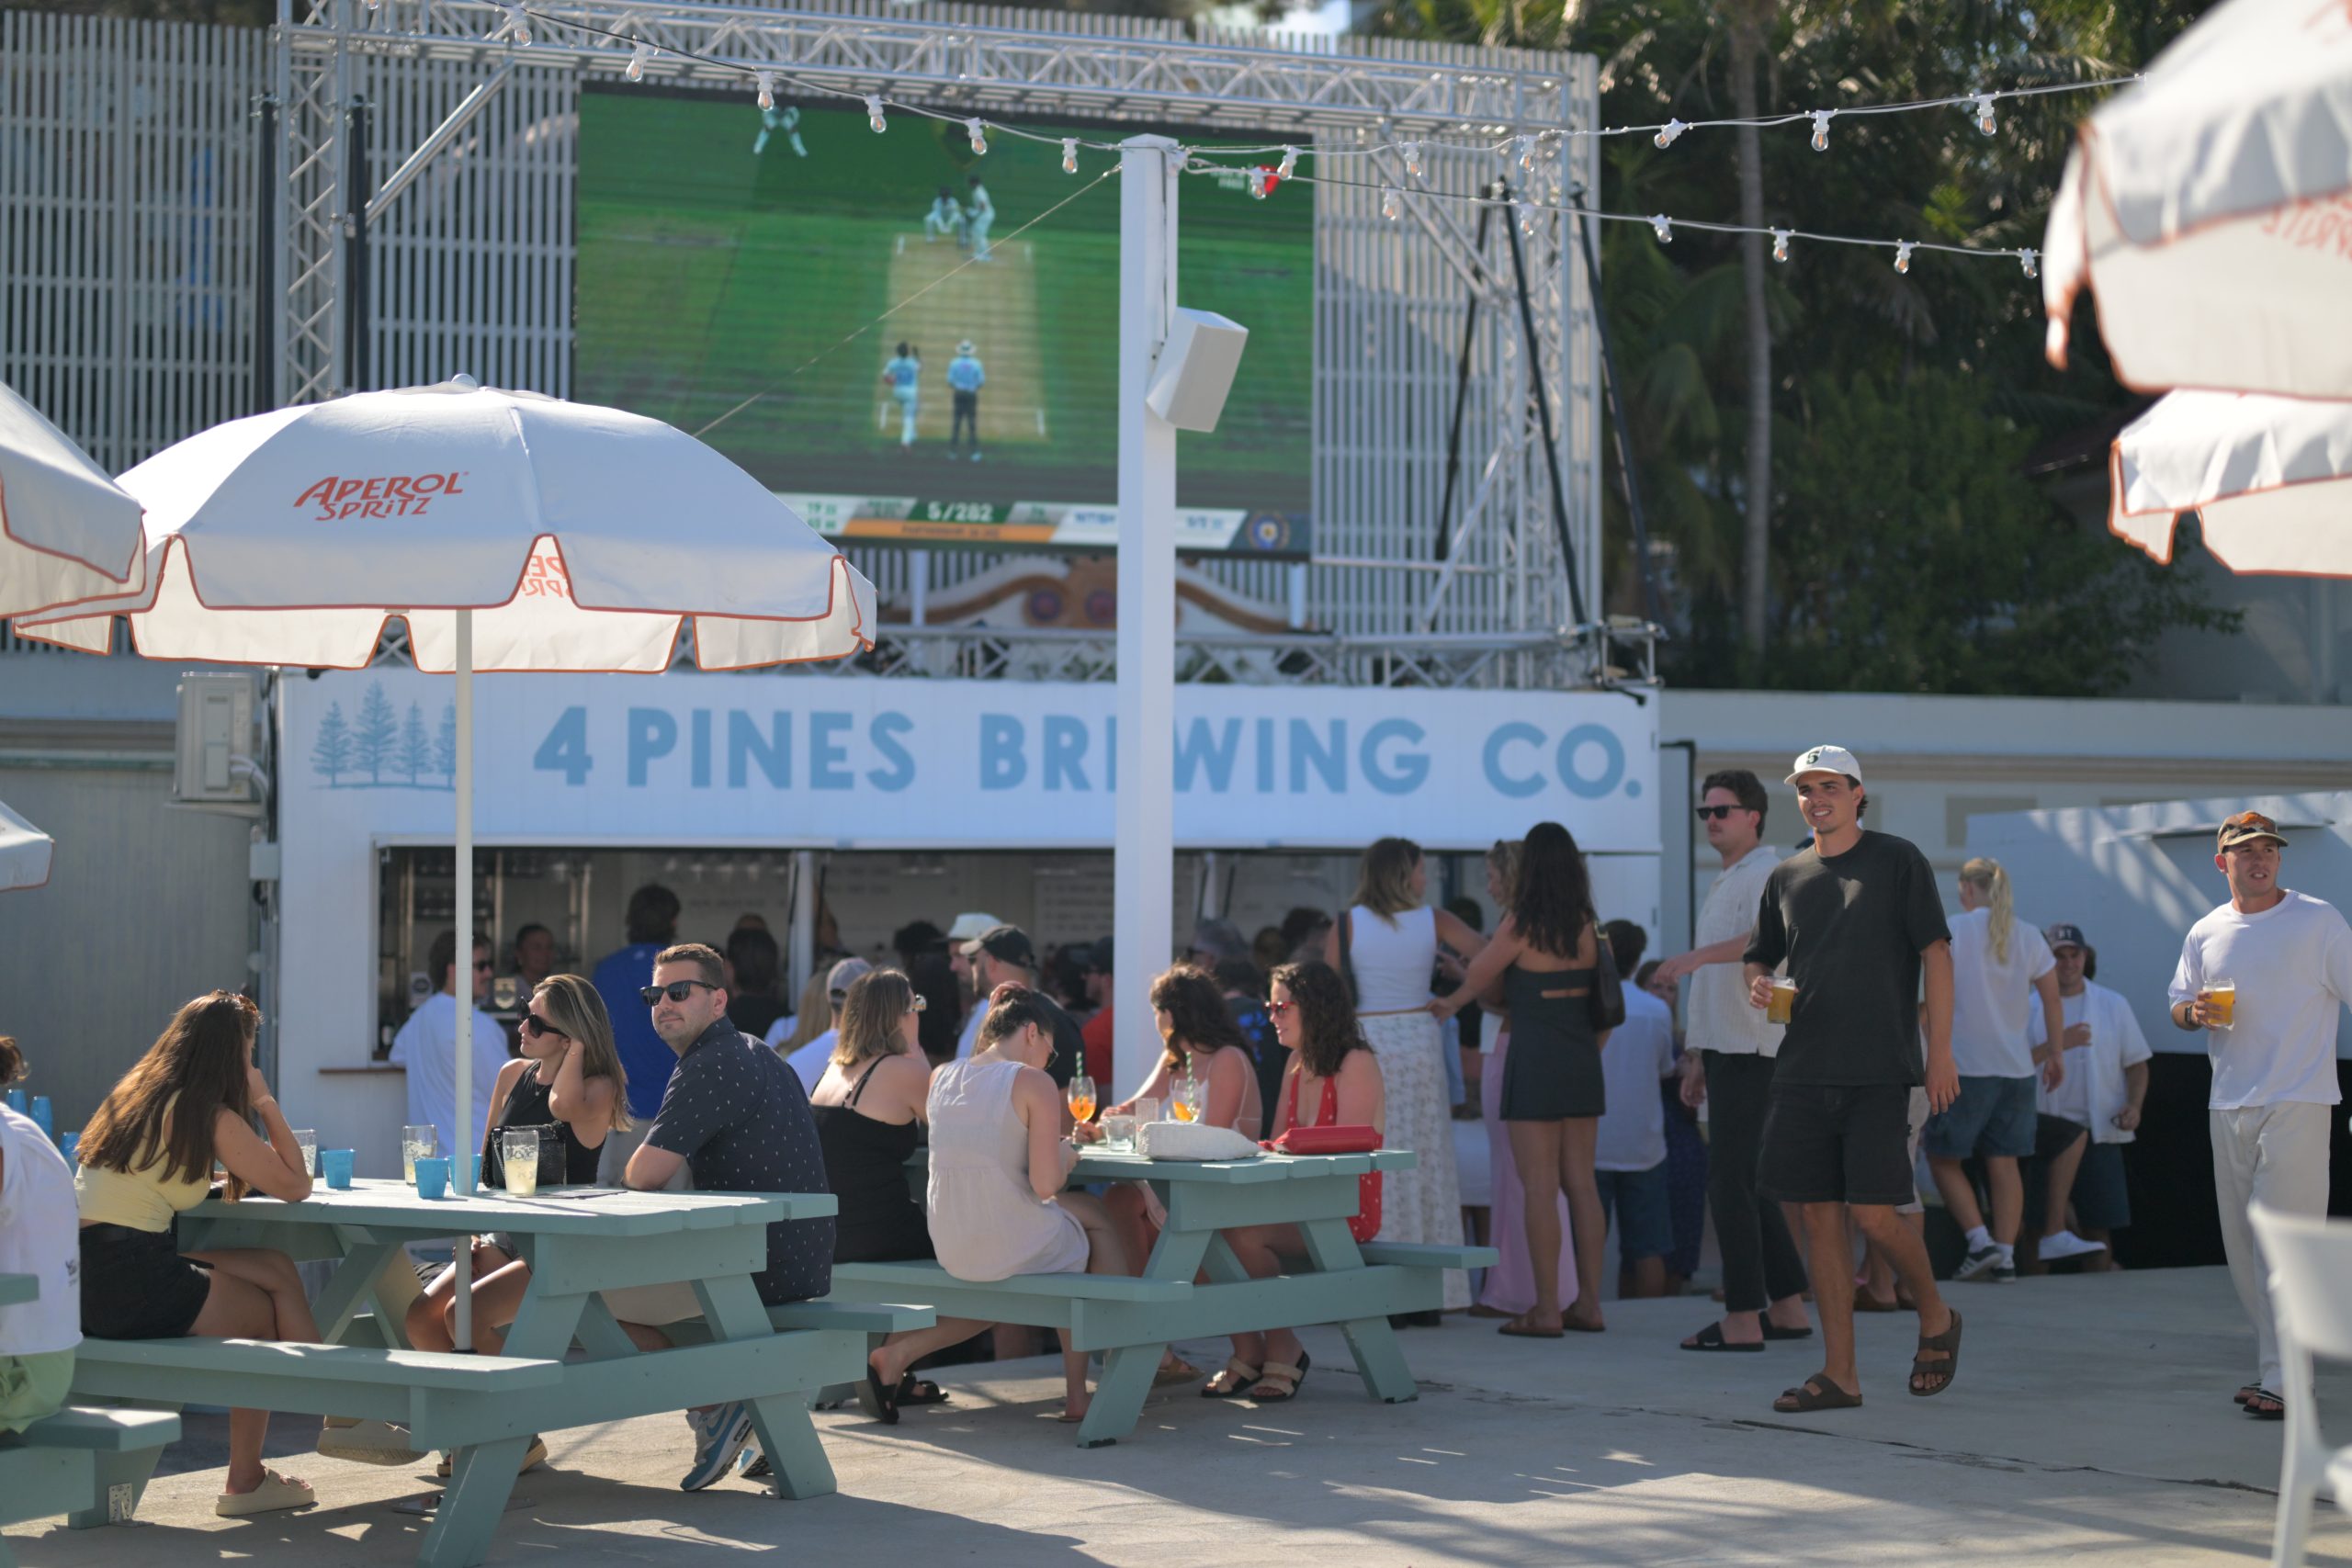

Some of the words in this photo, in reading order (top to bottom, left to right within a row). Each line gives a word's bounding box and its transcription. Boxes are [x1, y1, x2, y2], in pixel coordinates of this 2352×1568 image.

[293, 472, 464, 508] APEROL
[533, 706, 593, 786] 4
[627, 707, 916, 793] PINES
[1482, 722, 1643, 799] CO.
